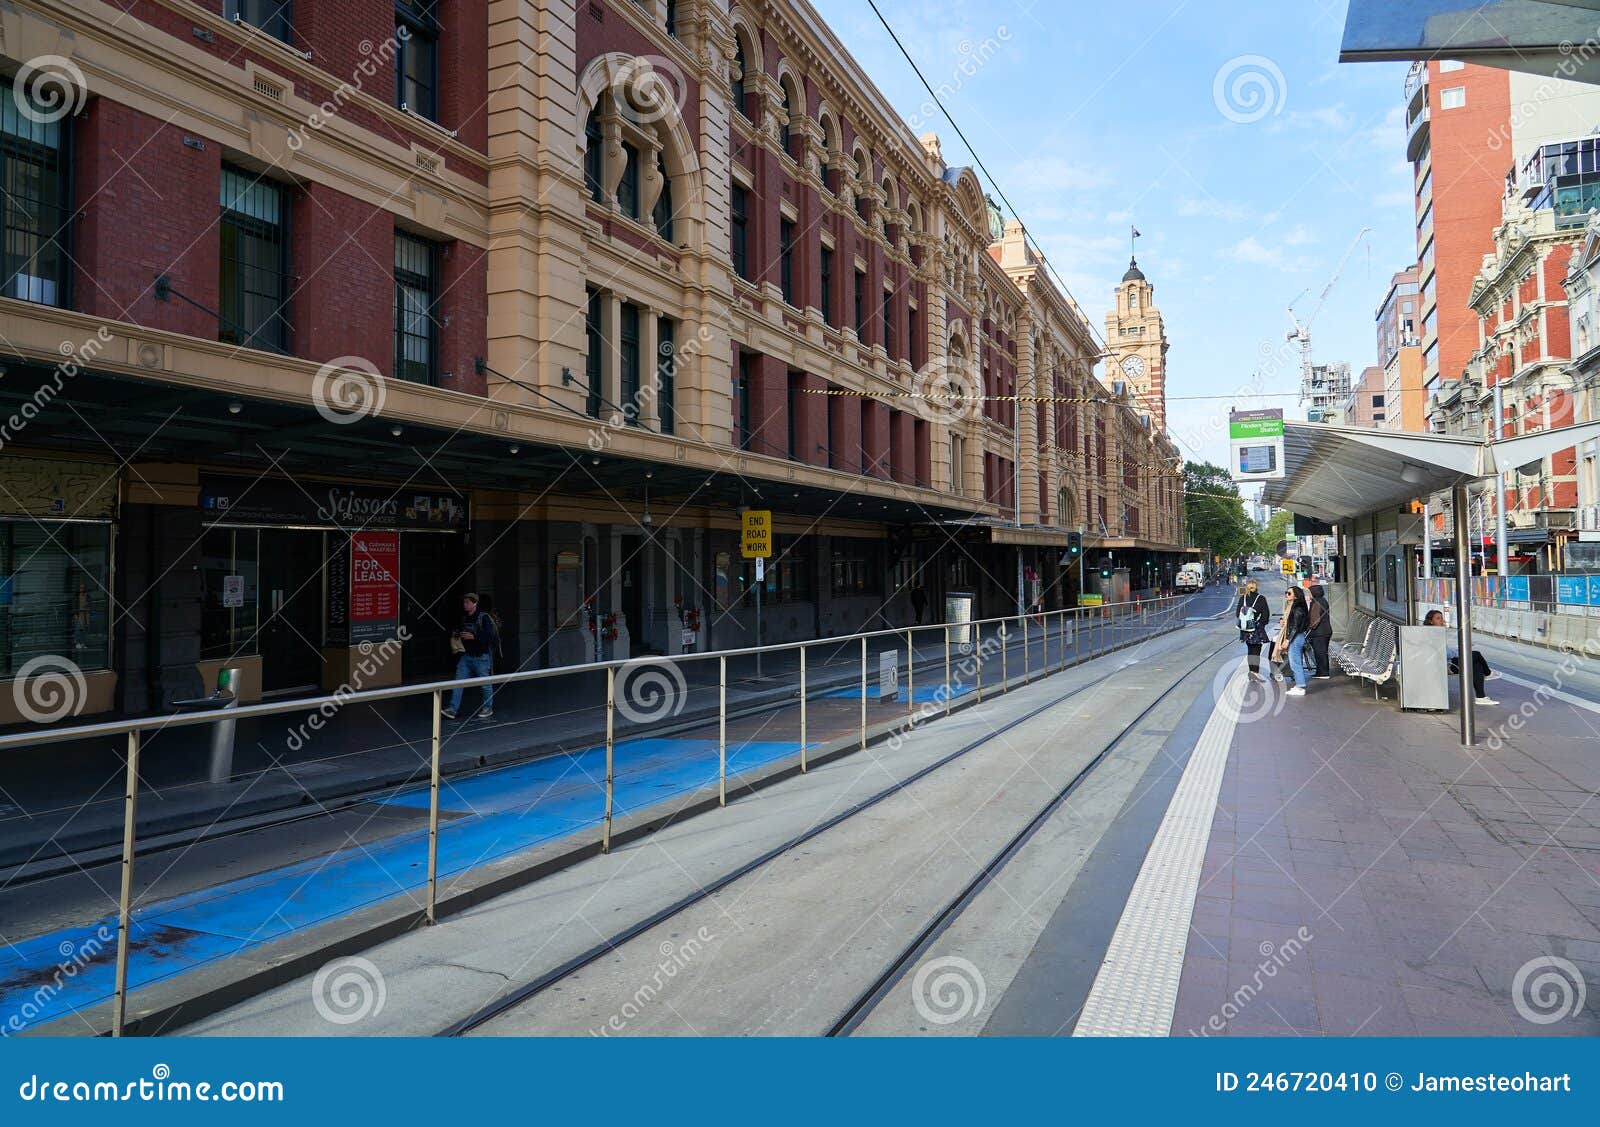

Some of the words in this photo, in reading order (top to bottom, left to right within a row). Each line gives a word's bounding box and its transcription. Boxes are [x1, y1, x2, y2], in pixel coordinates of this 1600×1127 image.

[317, 488, 398, 520] Scissors
[749, 516, 764, 526] END
[746, 530, 767, 539] ROAD
[746, 543, 767, 552] WORK
[354, 560, 378, 570] FOR
[354, 571, 390, 582] LEASE
